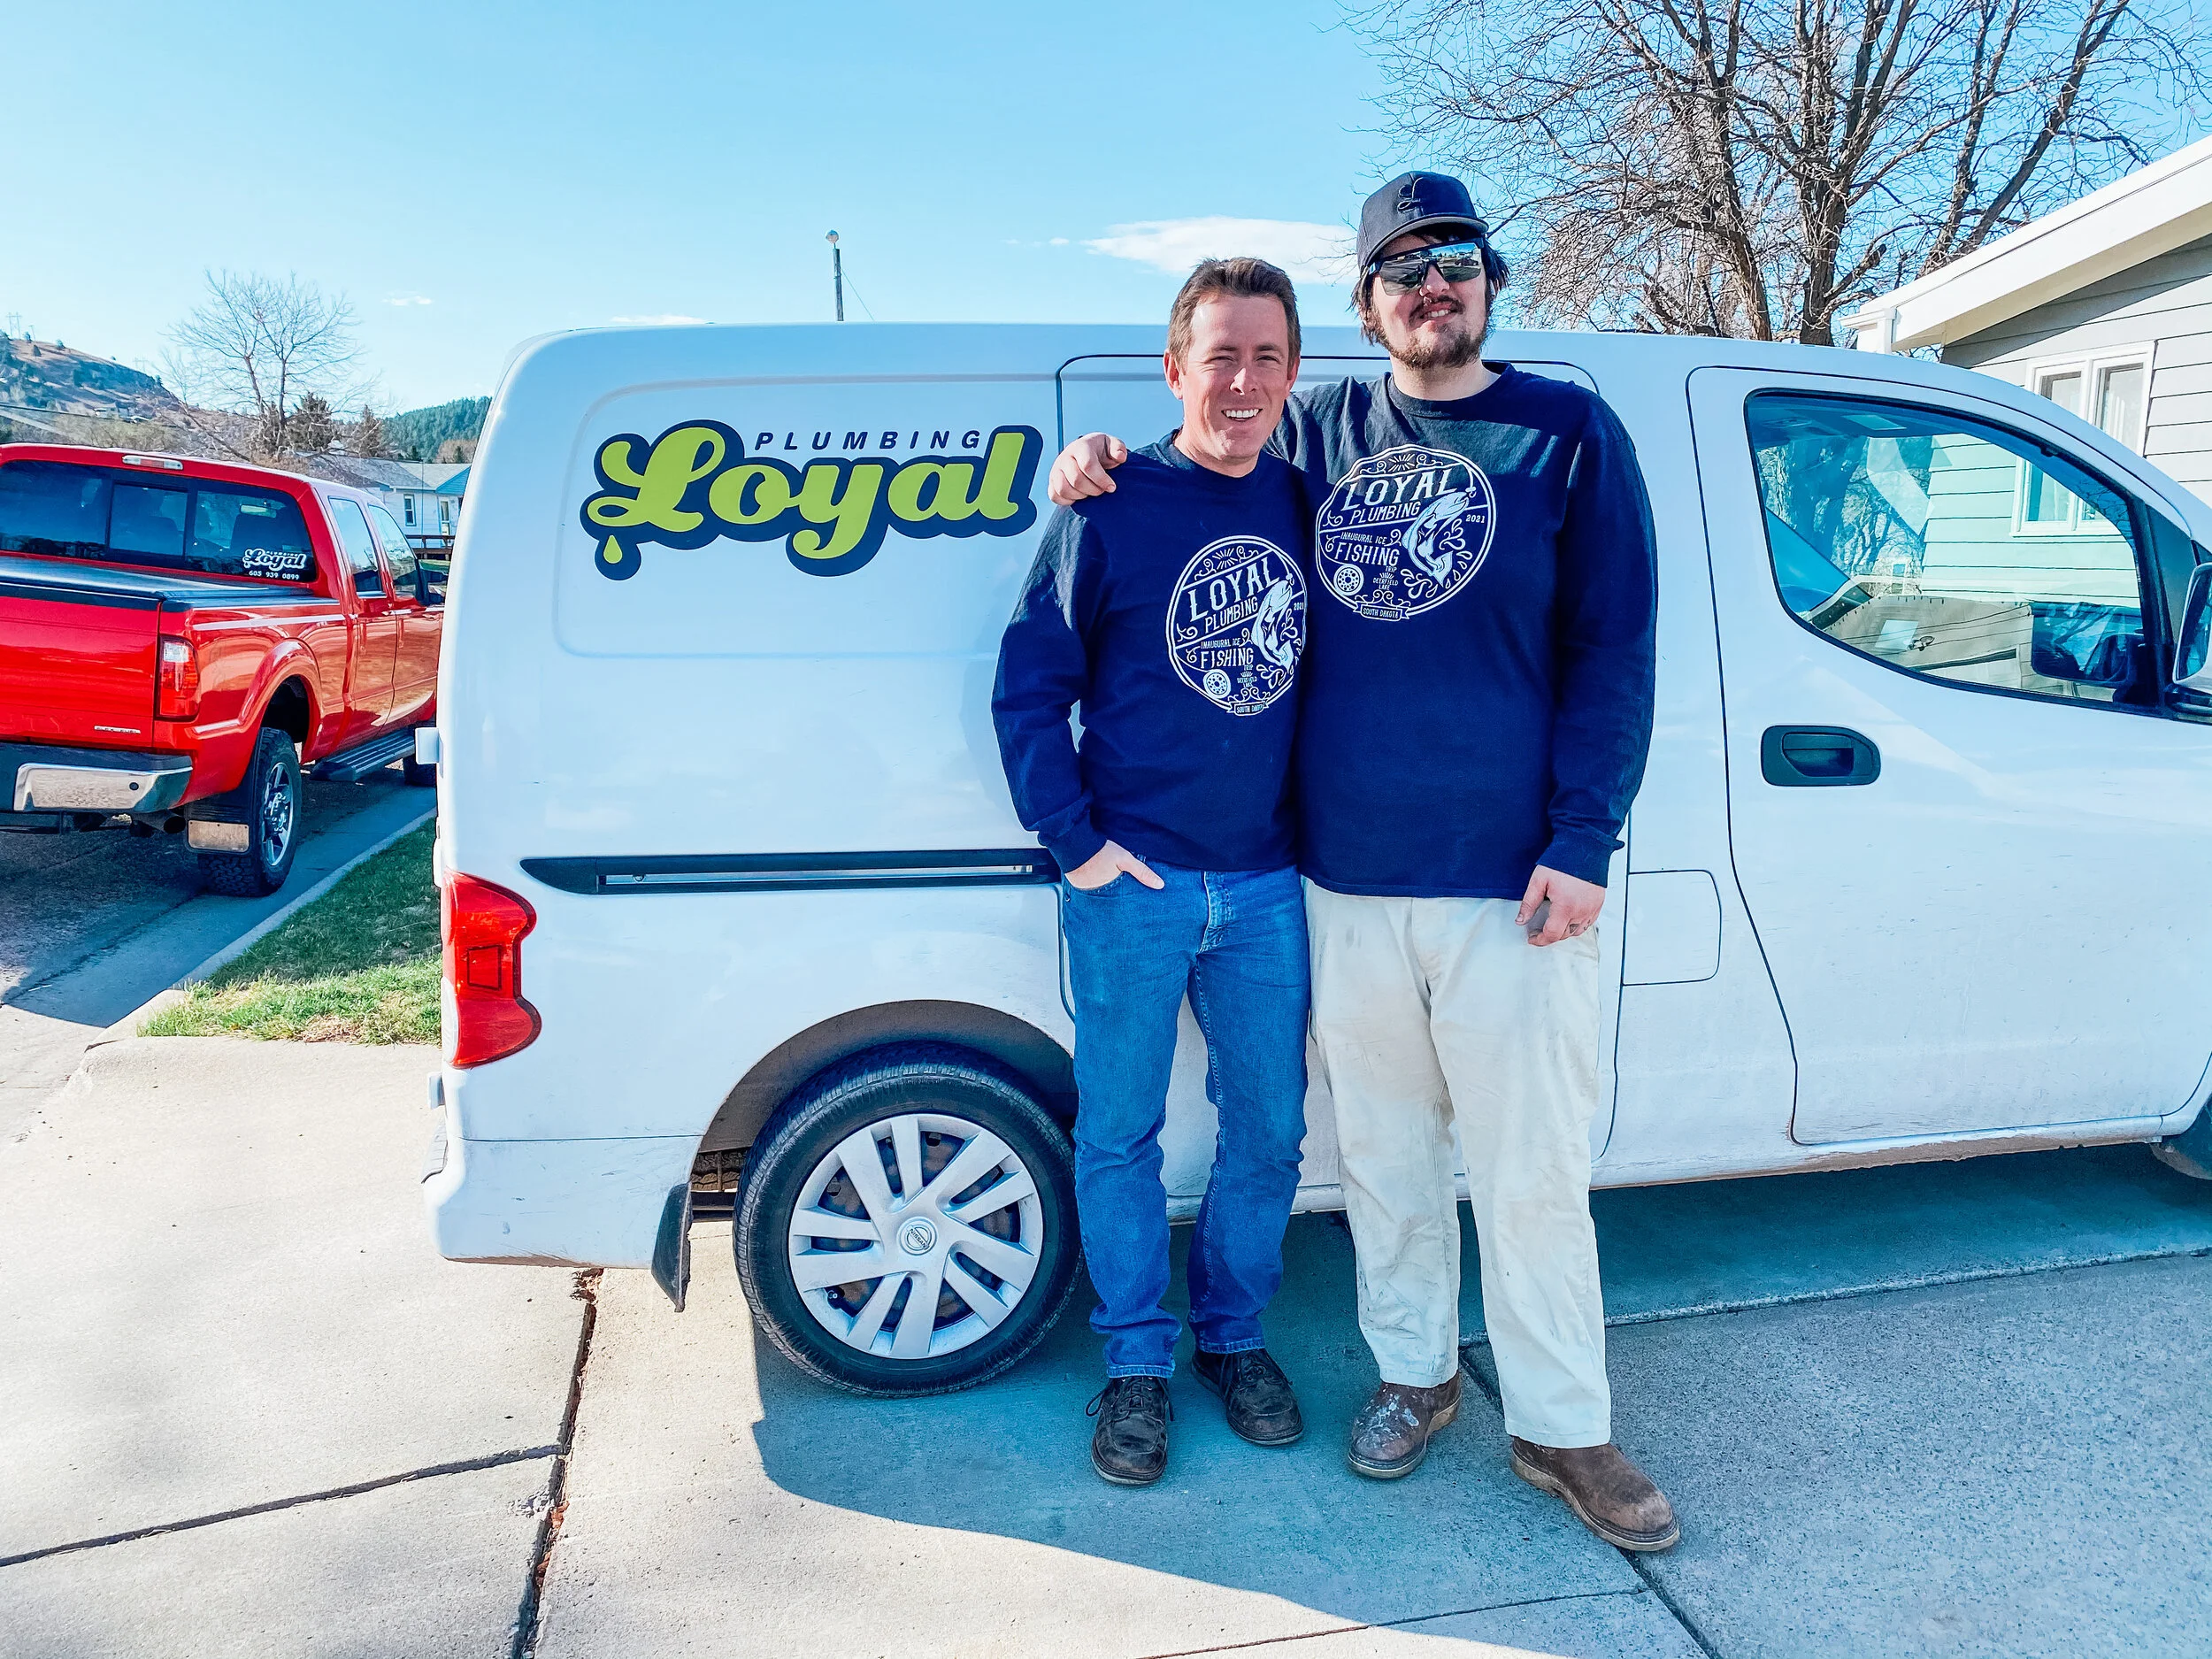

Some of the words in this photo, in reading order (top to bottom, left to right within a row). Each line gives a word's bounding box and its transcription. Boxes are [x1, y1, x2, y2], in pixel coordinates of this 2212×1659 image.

[754, 431, 981, 451] PLUMBING
[584, 423, 1035, 567] Loyal
[1340, 468, 1457, 511] LOYAL
[1349, 501, 1421, 525] PLUMBING
[1465, 514, 1486, 524] 2021
[1340, 532, 1372, 543] INAUGURAL
[1375, 536, 1387, 545] ICE
[242, 549, 307, 572] Loyal
[1334, 542, 1400, 566] FISHING
[1187, 557, 1279, 622] LOYAL
[1204, 596, 1258, 634] PLUMBING
[1363, 608, 1379, 617] SOUTH
[1380, 610, 1399, 619] DAKOTA
[1201, 647, 1254, 669] FISHING
